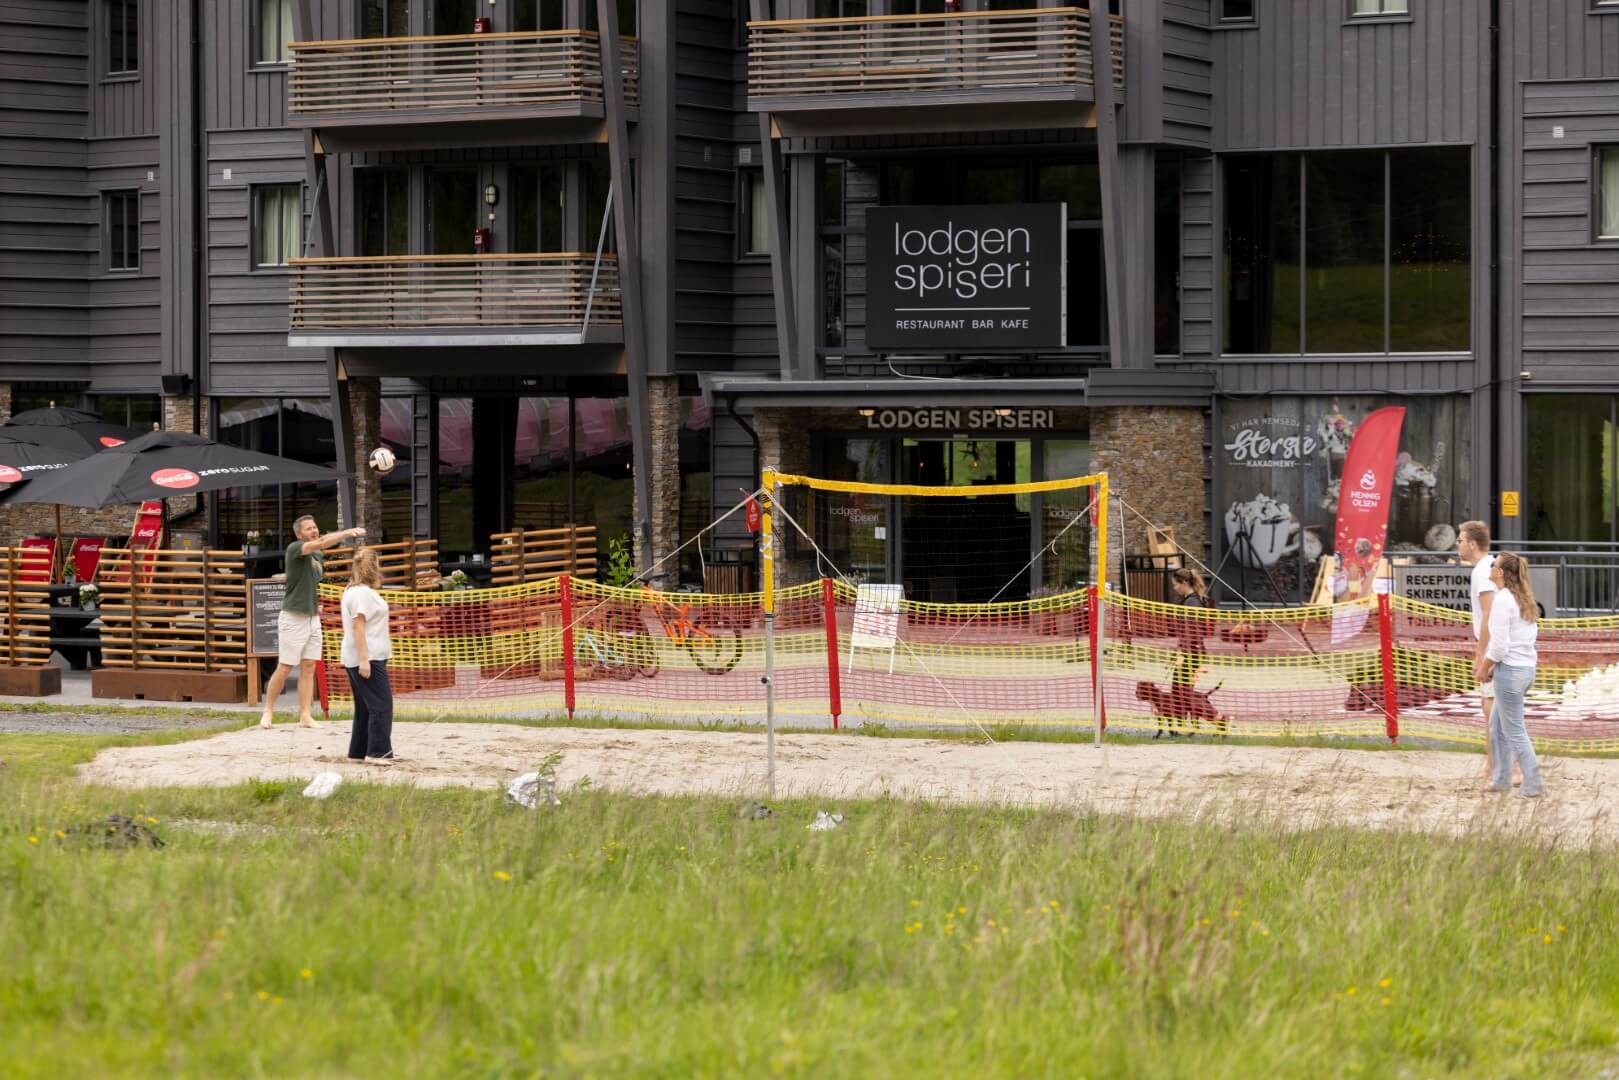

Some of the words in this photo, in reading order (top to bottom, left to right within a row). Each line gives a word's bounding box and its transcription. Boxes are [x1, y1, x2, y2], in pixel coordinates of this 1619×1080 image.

[895, 221, 1030, 265] lodgen
[894, 261, 1030, 298] spiseri
[896, 320, 965, 329] RESTAURANT
[972, 320, 994, 329] BAR
[1001, 319, 1029, 328] KAFE
[867, 410, 960, 429] LODGEN
[968, 410, 1054, 428] SPISERI
[1406, 575, 1471, 585] RECEPTION
[1406, 589, 1471, 599] SKIRENTAL
